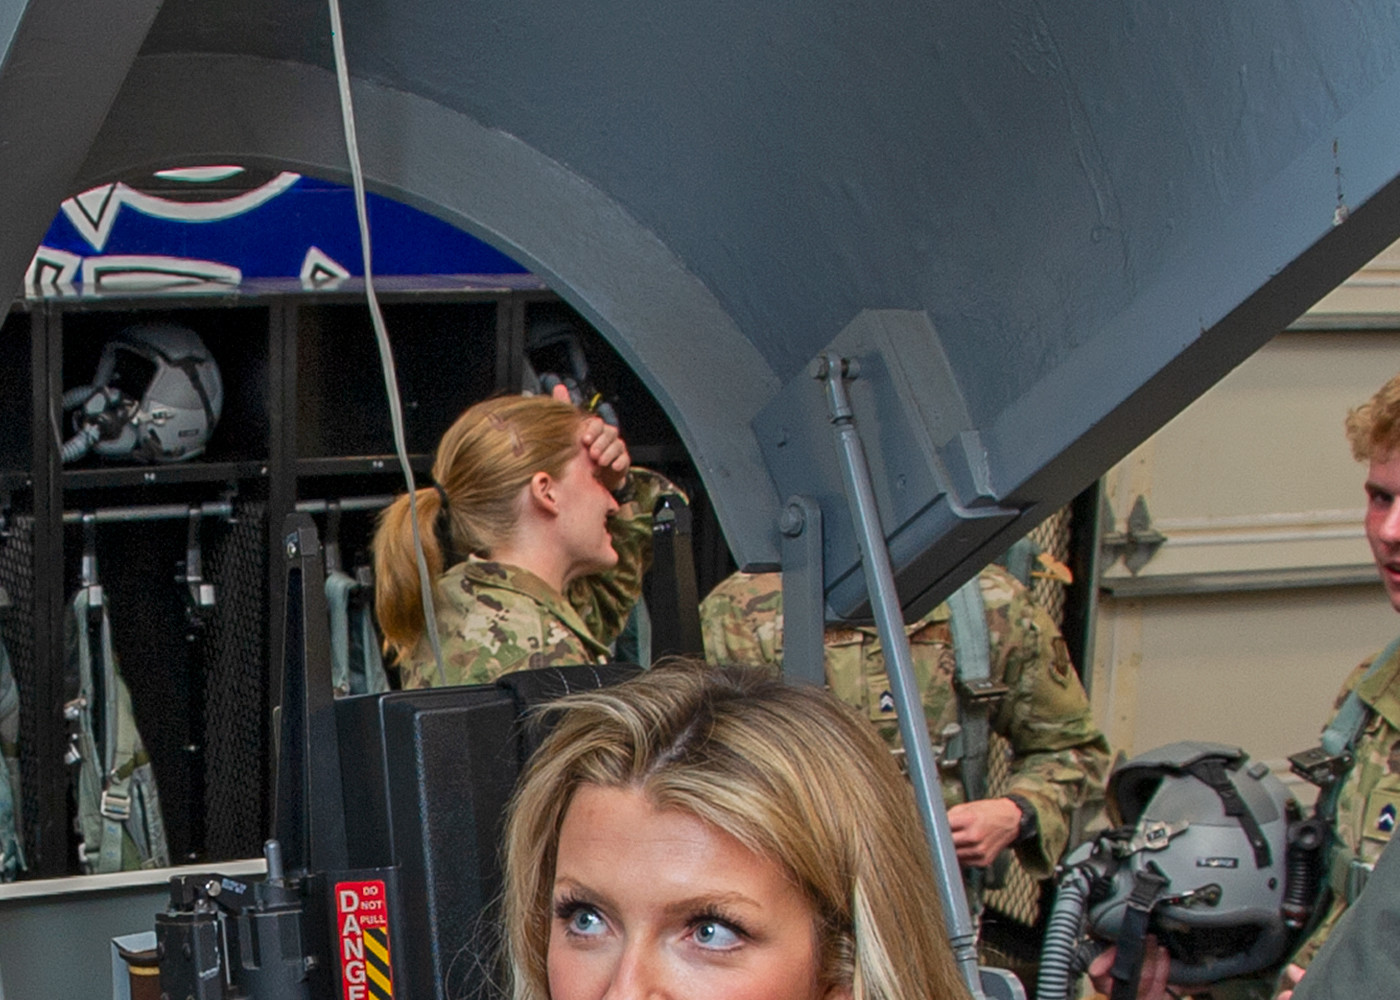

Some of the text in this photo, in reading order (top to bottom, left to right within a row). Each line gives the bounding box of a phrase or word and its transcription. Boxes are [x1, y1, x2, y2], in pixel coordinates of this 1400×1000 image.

[362, 886, 379, 896] DO
[361, 900, 382, 910] NOT
[360, 914, 386, 925] PULL
